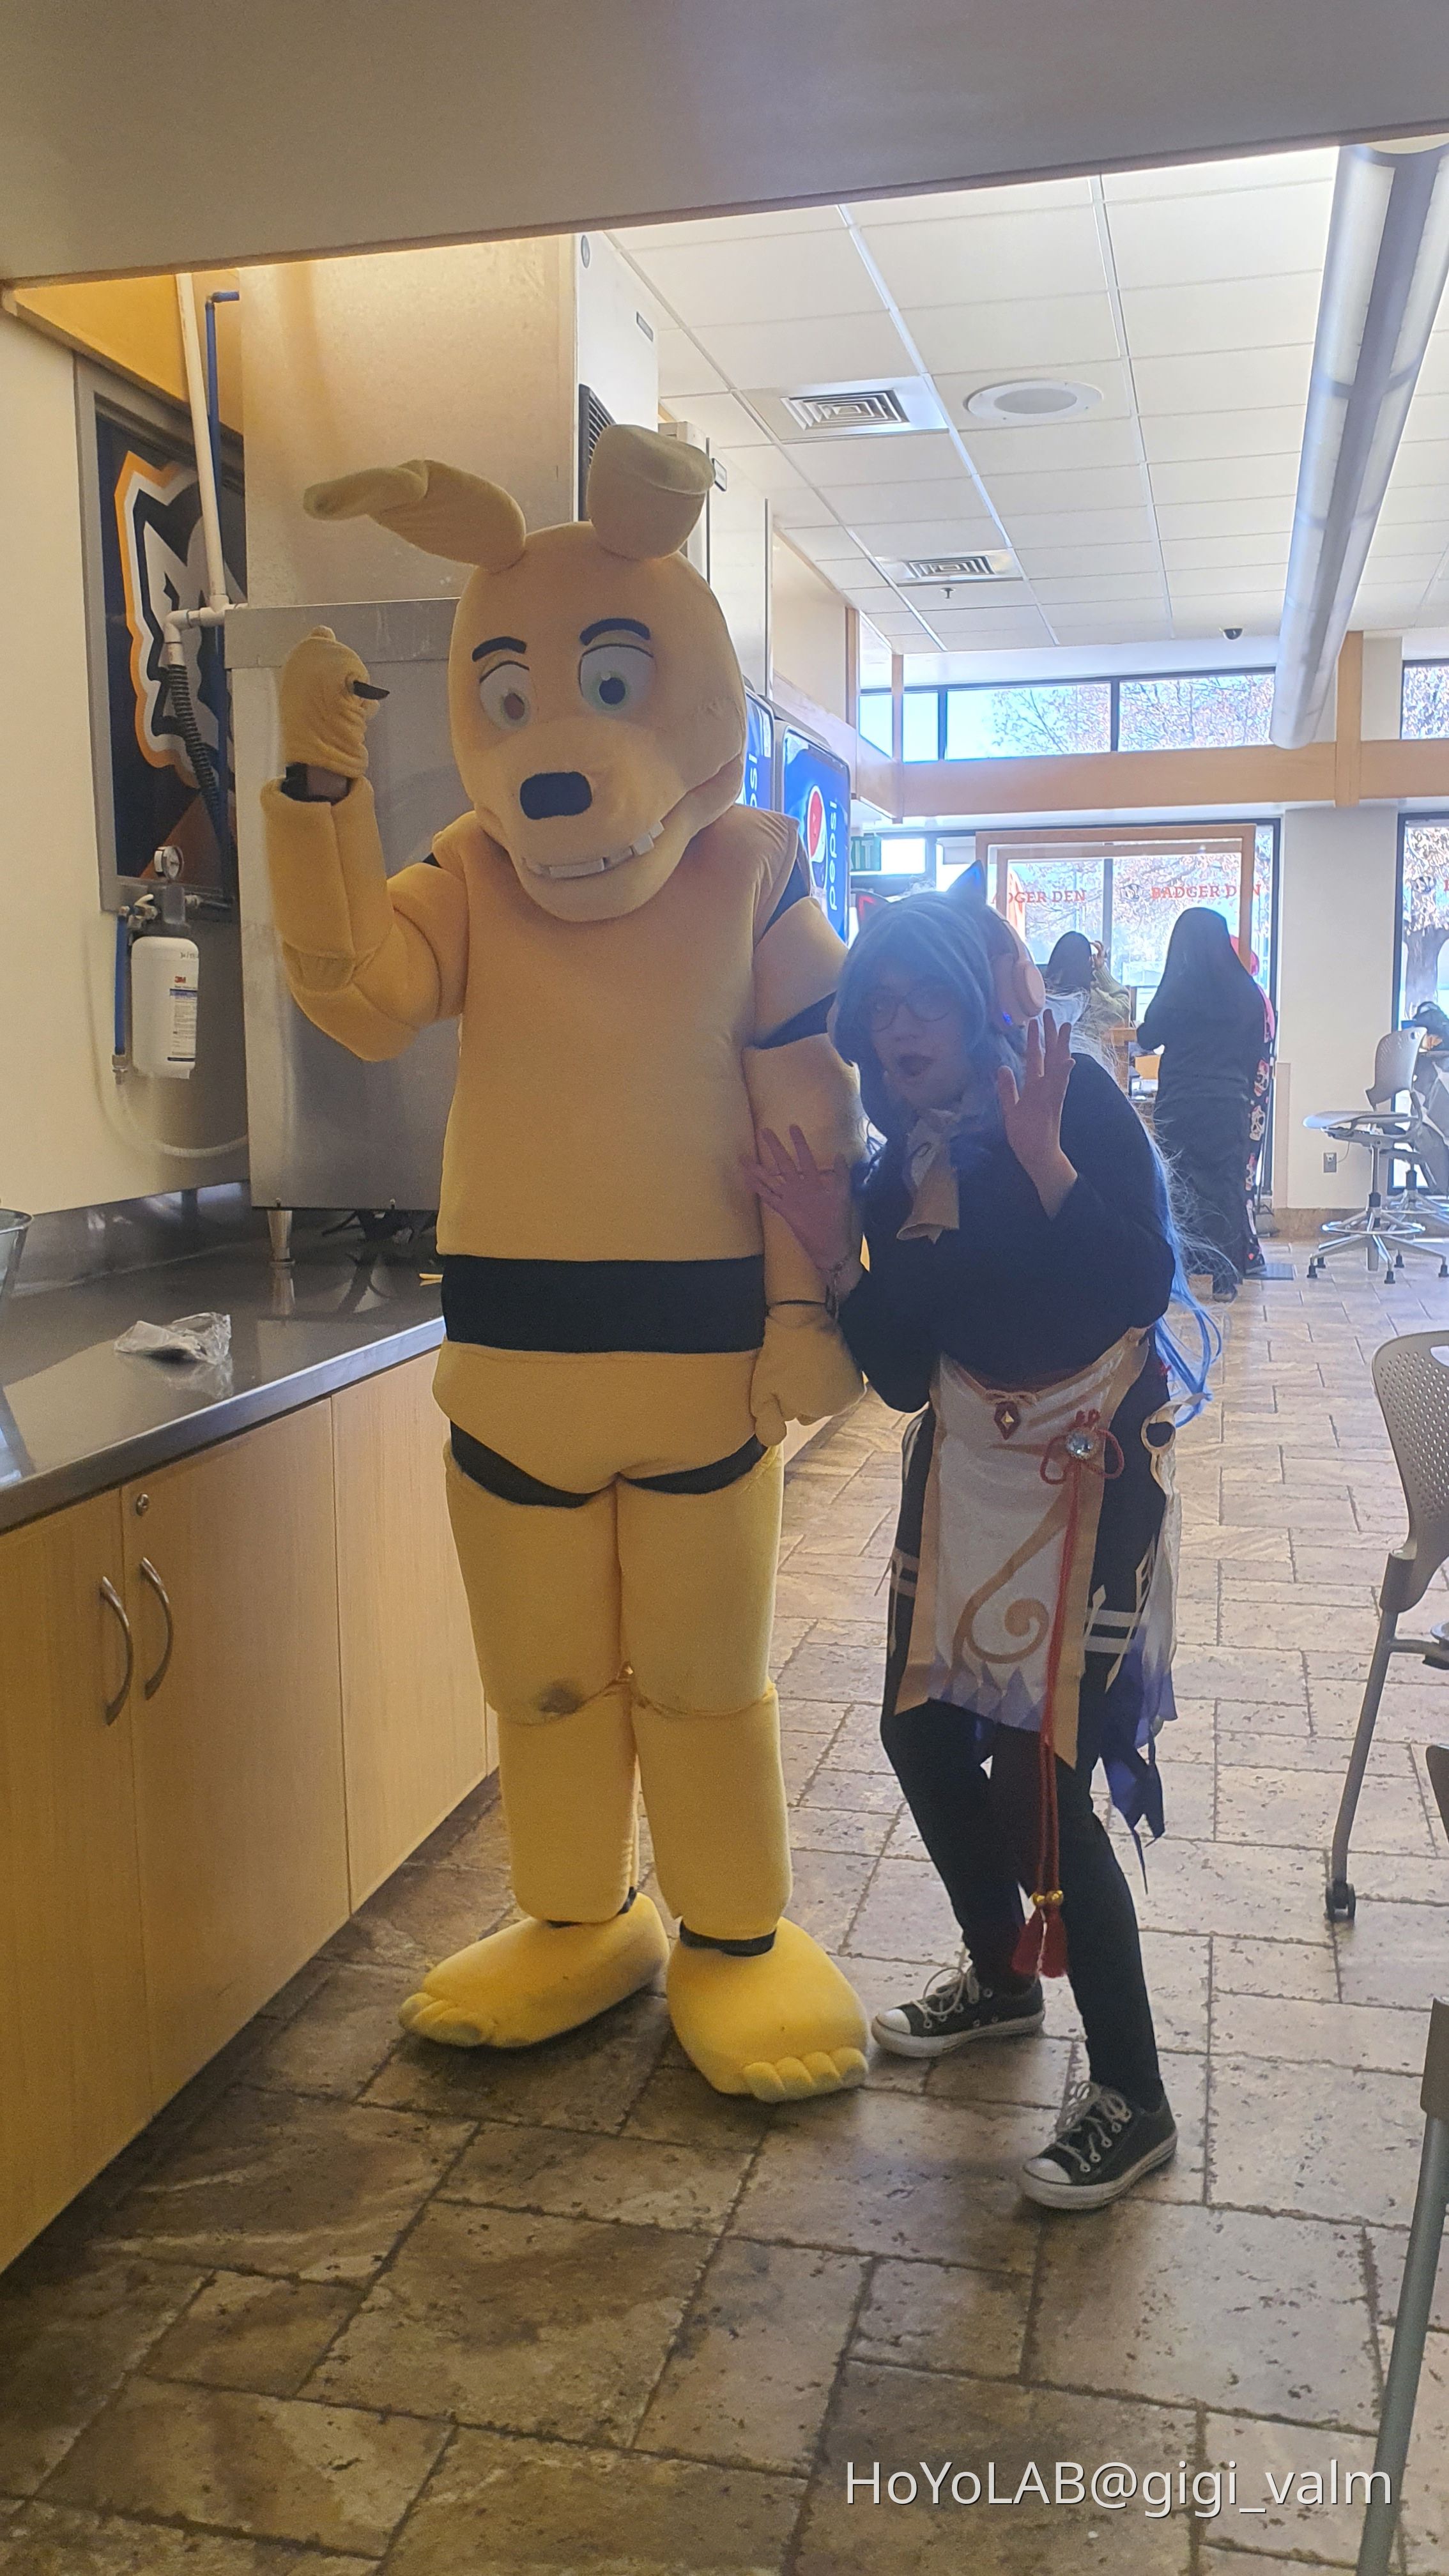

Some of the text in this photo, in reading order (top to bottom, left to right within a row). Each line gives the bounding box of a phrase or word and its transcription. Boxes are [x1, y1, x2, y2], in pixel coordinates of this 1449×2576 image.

[1052, 889, 1086, 903] DEN
[1151, 884, 1261, 900] BADGER DN
